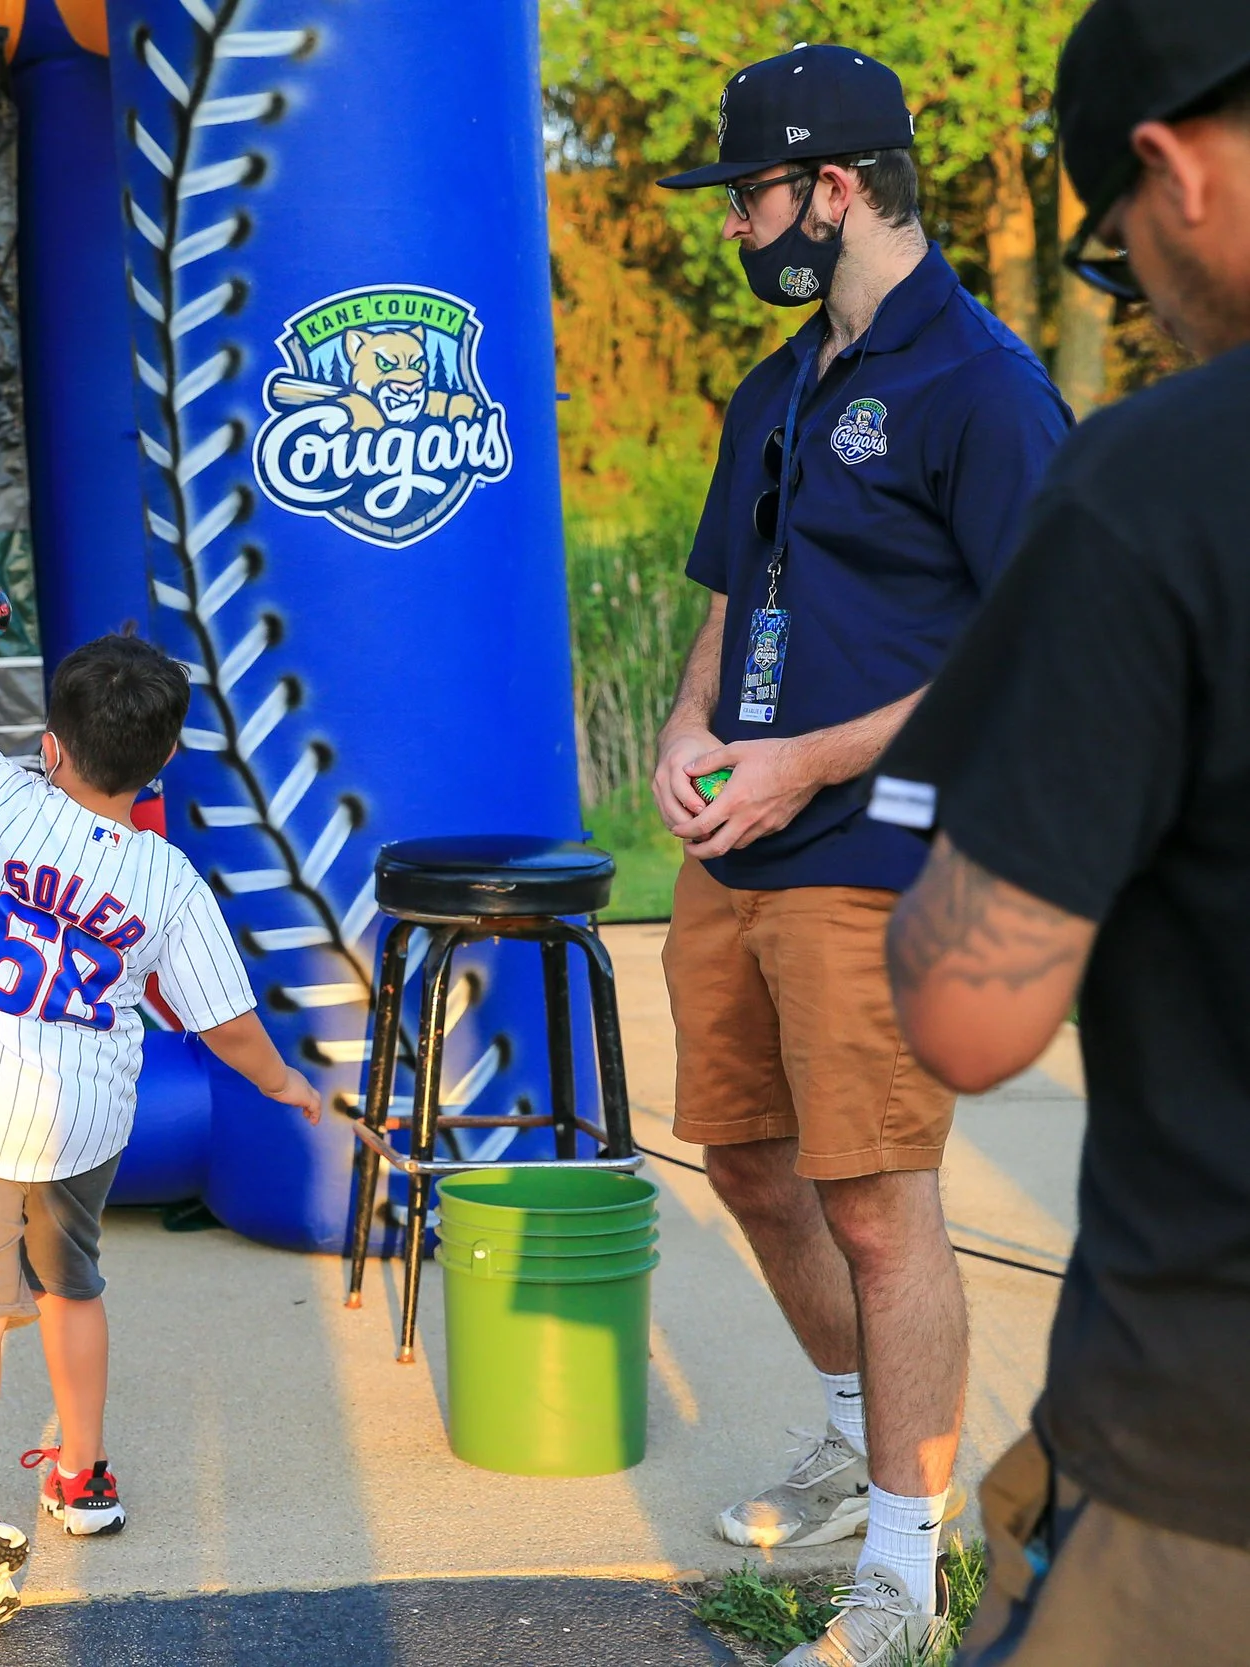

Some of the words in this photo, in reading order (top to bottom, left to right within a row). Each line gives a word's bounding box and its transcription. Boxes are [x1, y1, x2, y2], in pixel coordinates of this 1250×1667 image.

[306, 304, 363, 338] KANE
[375, 300, 458, 326] COUNTY
[262, 405, 506, 519] Cougars
[833, 425, 885, 456] Cougars
[4, 859, 146, 950] SOLER
